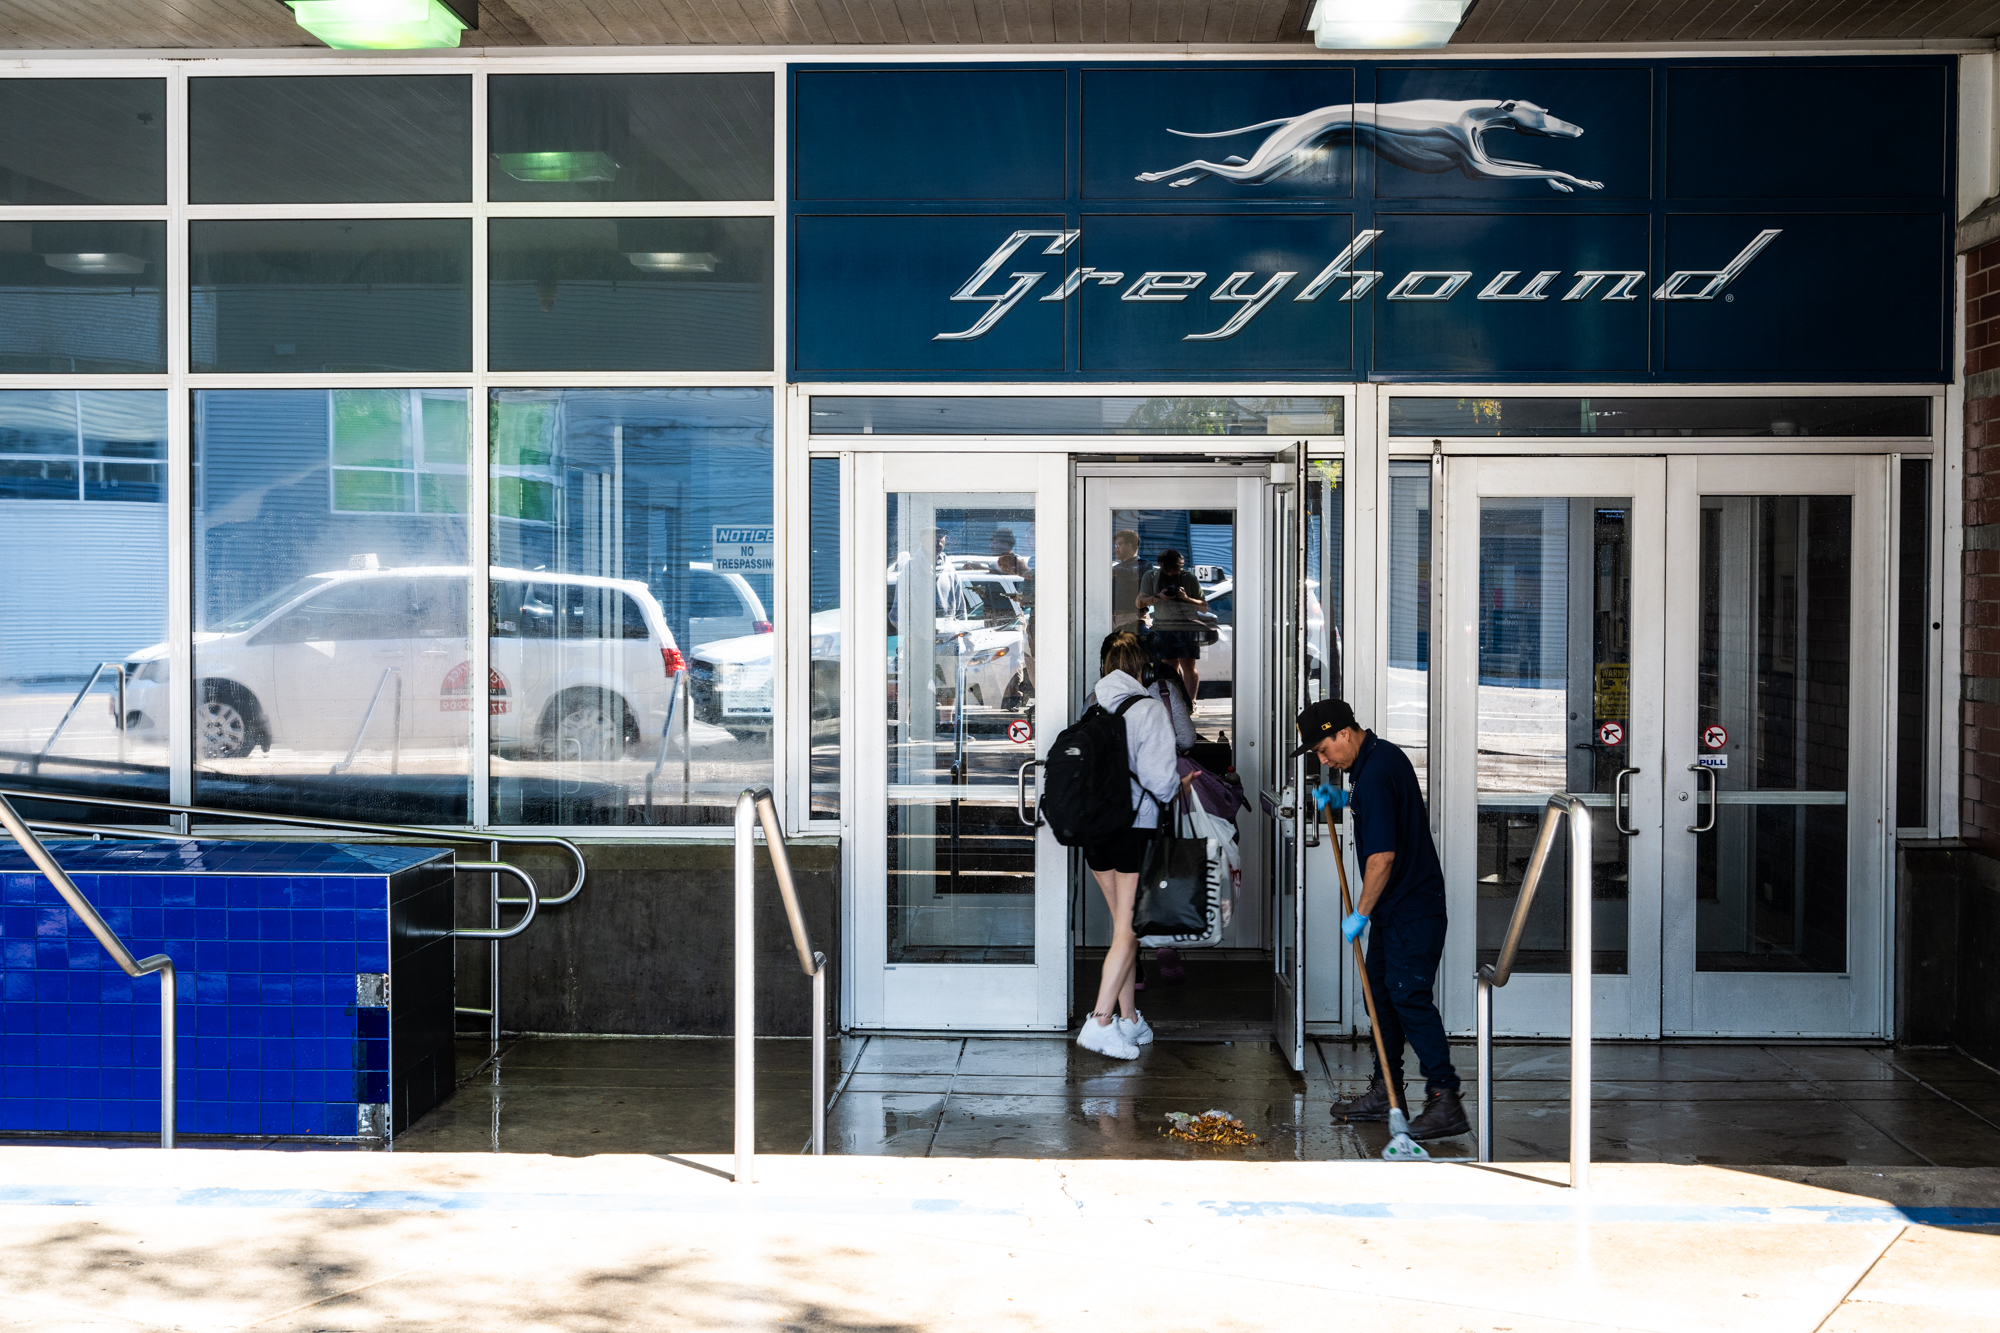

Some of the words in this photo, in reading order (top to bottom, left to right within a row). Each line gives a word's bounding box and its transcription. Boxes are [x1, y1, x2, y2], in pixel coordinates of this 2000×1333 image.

[931, 228, 1782, 341] Greyhound
[718, 529, 774, 542] NOTICE
[740, 545, 754, 557] NO
[716, 558, 774, 570] TRESPASSIN
